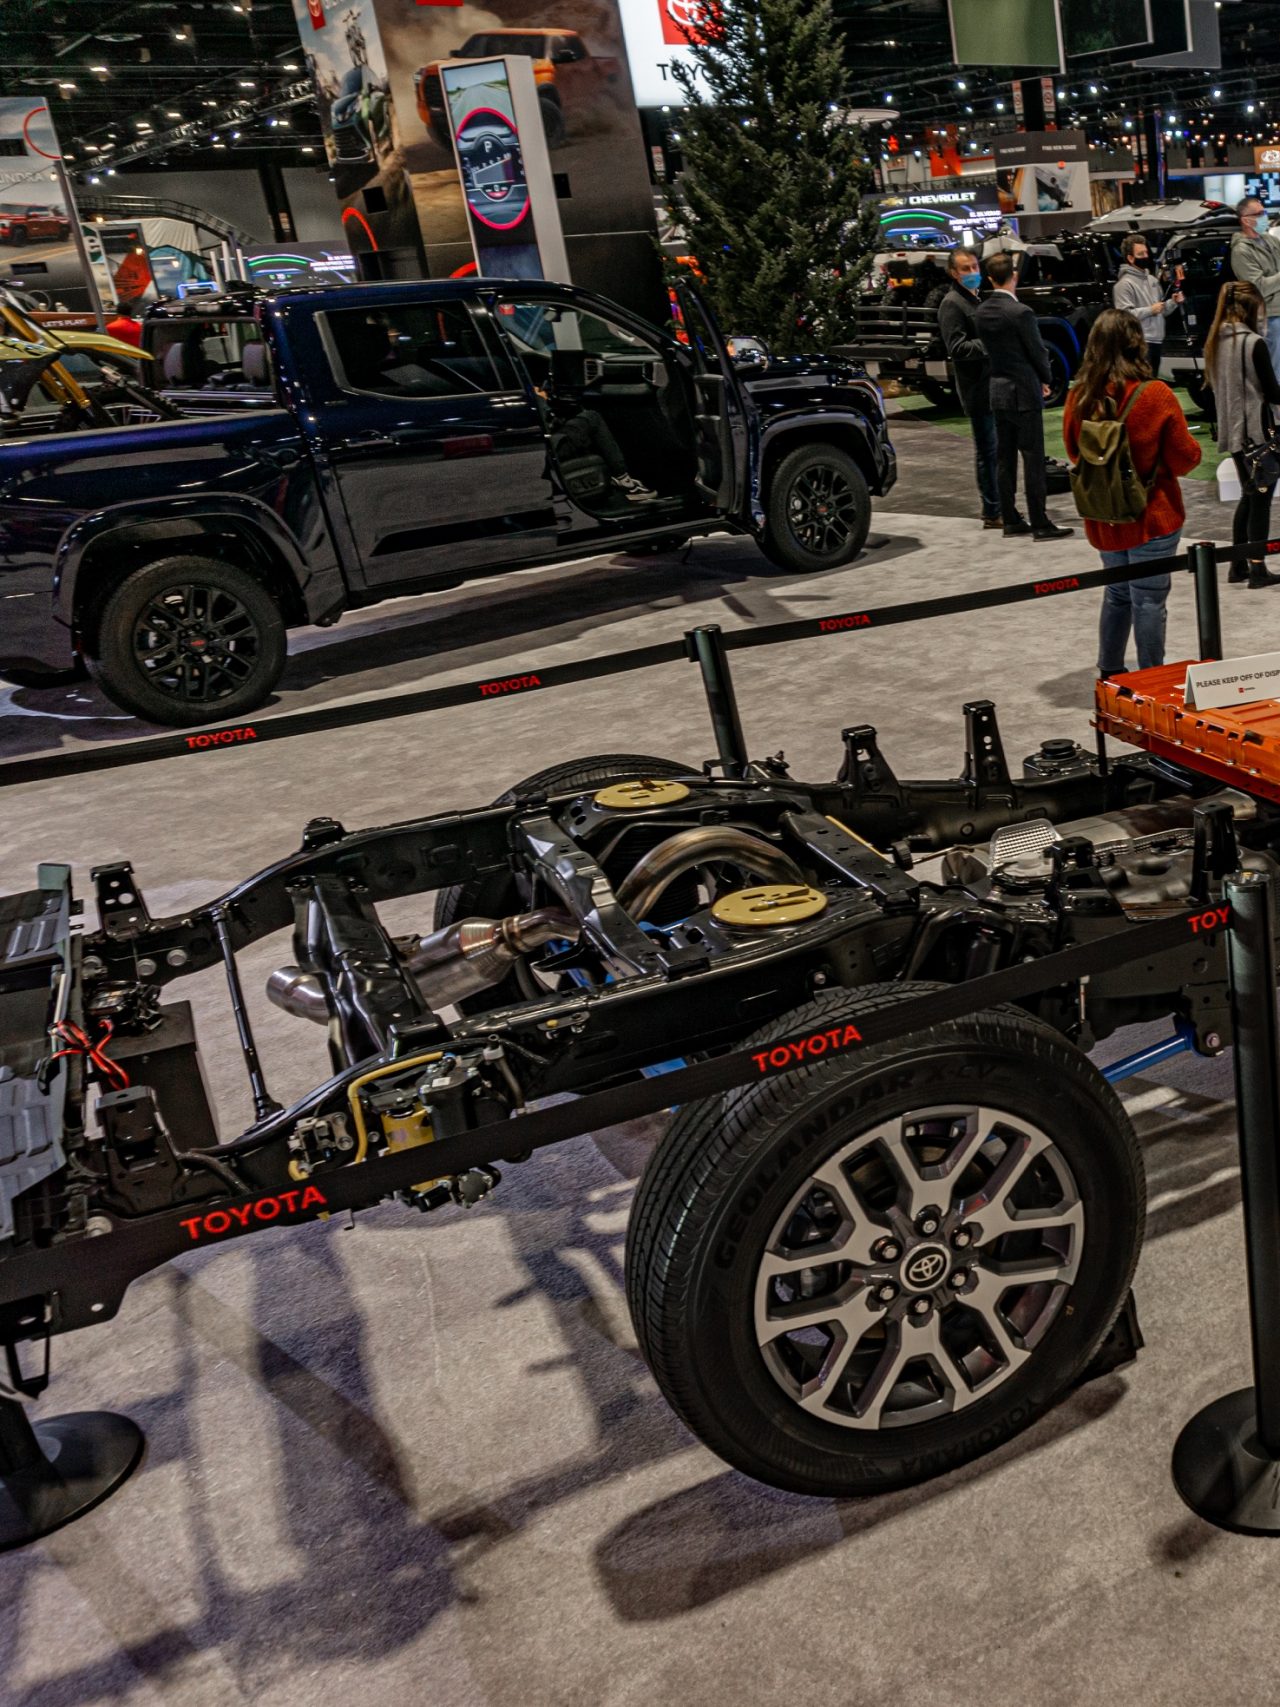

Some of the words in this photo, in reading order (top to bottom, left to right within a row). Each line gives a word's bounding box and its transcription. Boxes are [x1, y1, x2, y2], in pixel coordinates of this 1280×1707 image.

[909, 191, 976, 205] CHEVROLET
[1033, 577, 1080, 595] TOYOTA
[818, 612, 872, 632] TOYOTA
[478, 674, 541, 697] TOYOTA
[1196, 678, 1221, 688] PLEASE
[1222, 676, 1239, 685] KEEP
[1239, 673, 1254, 682] OFF
[1254, 672, 1264, 680] OF
[185, 726, 257, 749] TOYOTA
[751, 1024, 863, 1073] TOYOTA
[178, 1185, 327, 1241] TOYOTA
